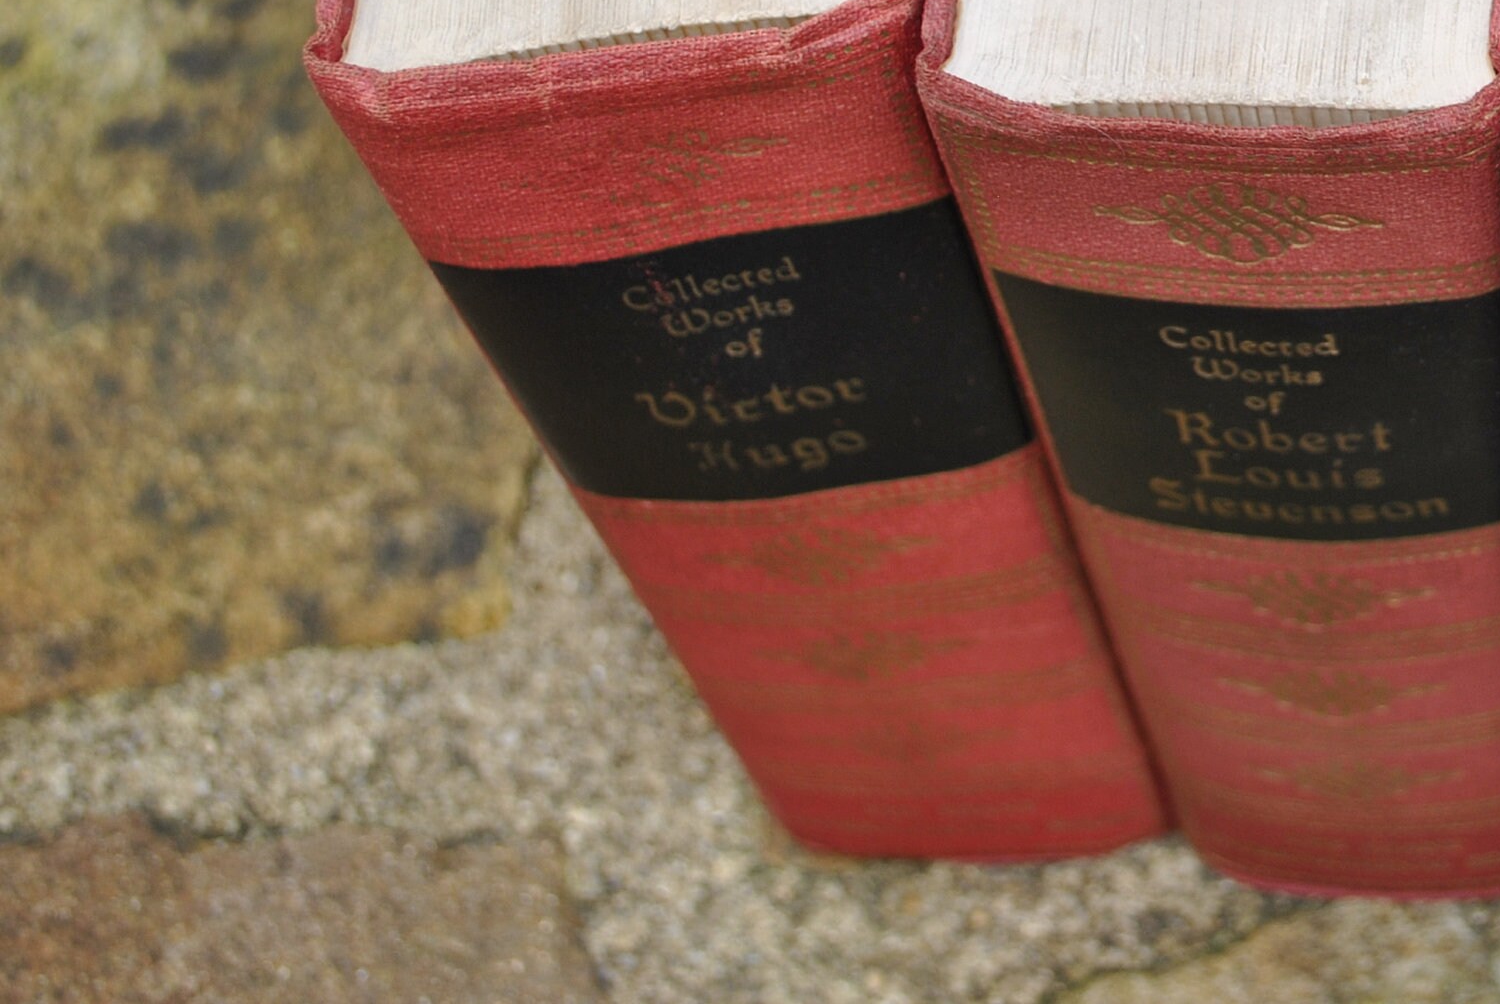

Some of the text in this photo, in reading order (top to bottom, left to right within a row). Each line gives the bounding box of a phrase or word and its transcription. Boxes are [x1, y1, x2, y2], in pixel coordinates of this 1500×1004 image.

[622, 256, 800, 310] Collected
[661, 296, 795, 337] Works
[725, 328, 763, 358] of
[1159, 326, 1340, 357] Collected
[1191, 356, 1323, 385] Works
[635, 377, 864, 427] Victor
[1244, 391, 1286, 415] of
[689, 430, 867, 470] Hugo
[1163, 408, 1393, 453] Robert
[1194, 449, 1385, 490] Louis
[1150, 477, 1449, 524] Stevenson
